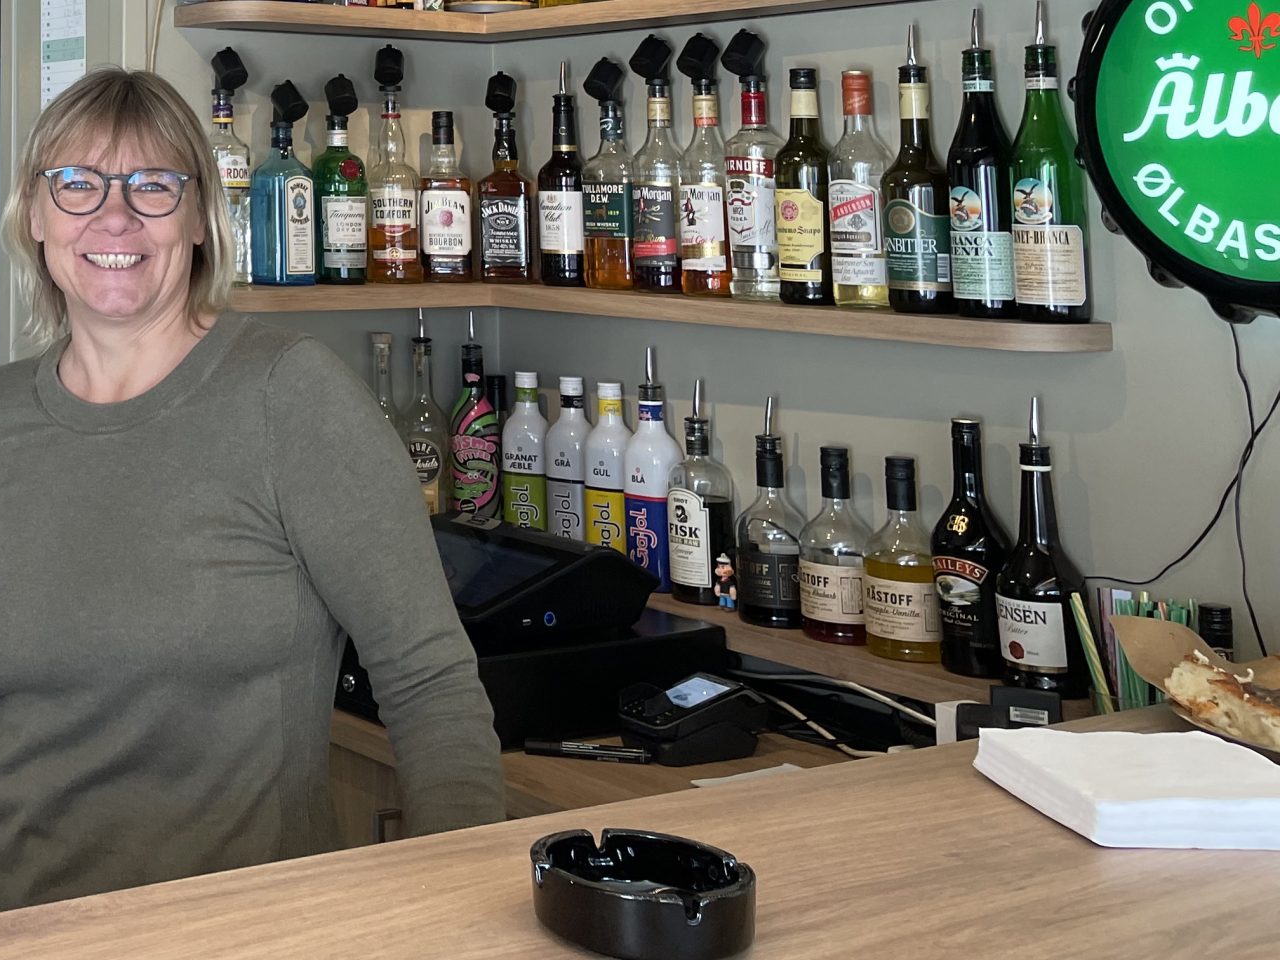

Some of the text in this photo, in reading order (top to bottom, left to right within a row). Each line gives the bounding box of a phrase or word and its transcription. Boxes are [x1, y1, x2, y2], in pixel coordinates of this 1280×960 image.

[290, 183, 309, 194] BOMBAY
[582, 184, 624, 195] TULLAMORE
[642, 187, 672, 202] Morgan
[372, 198, 414, 209] SOUTHERN
[425, 197, 465, 214] JIM BEAM
[837, 197, 872, 216] ANDERSON
[329, 209, 365, 221] Tanqueray
[375, 209, 412, 219] COMFORT
[481, 204, 498, 219] JACK
[543, 211, 562, 222] Club
[290, 215, 310, 225] SAPPHIRE
[429, 238, 463, 247] BOURBON
[410, 442, 433, 454] PURE
[505, 453, 538, 463] GRANAT
[554, 458, 571, 468] GRÅ
[509, 462, 533, 471] ÆBLE
[593, 468, 611, 478] GUL
[631, 473, 646, 484] BLÅ
[669, 522, 700, 539] FISK
